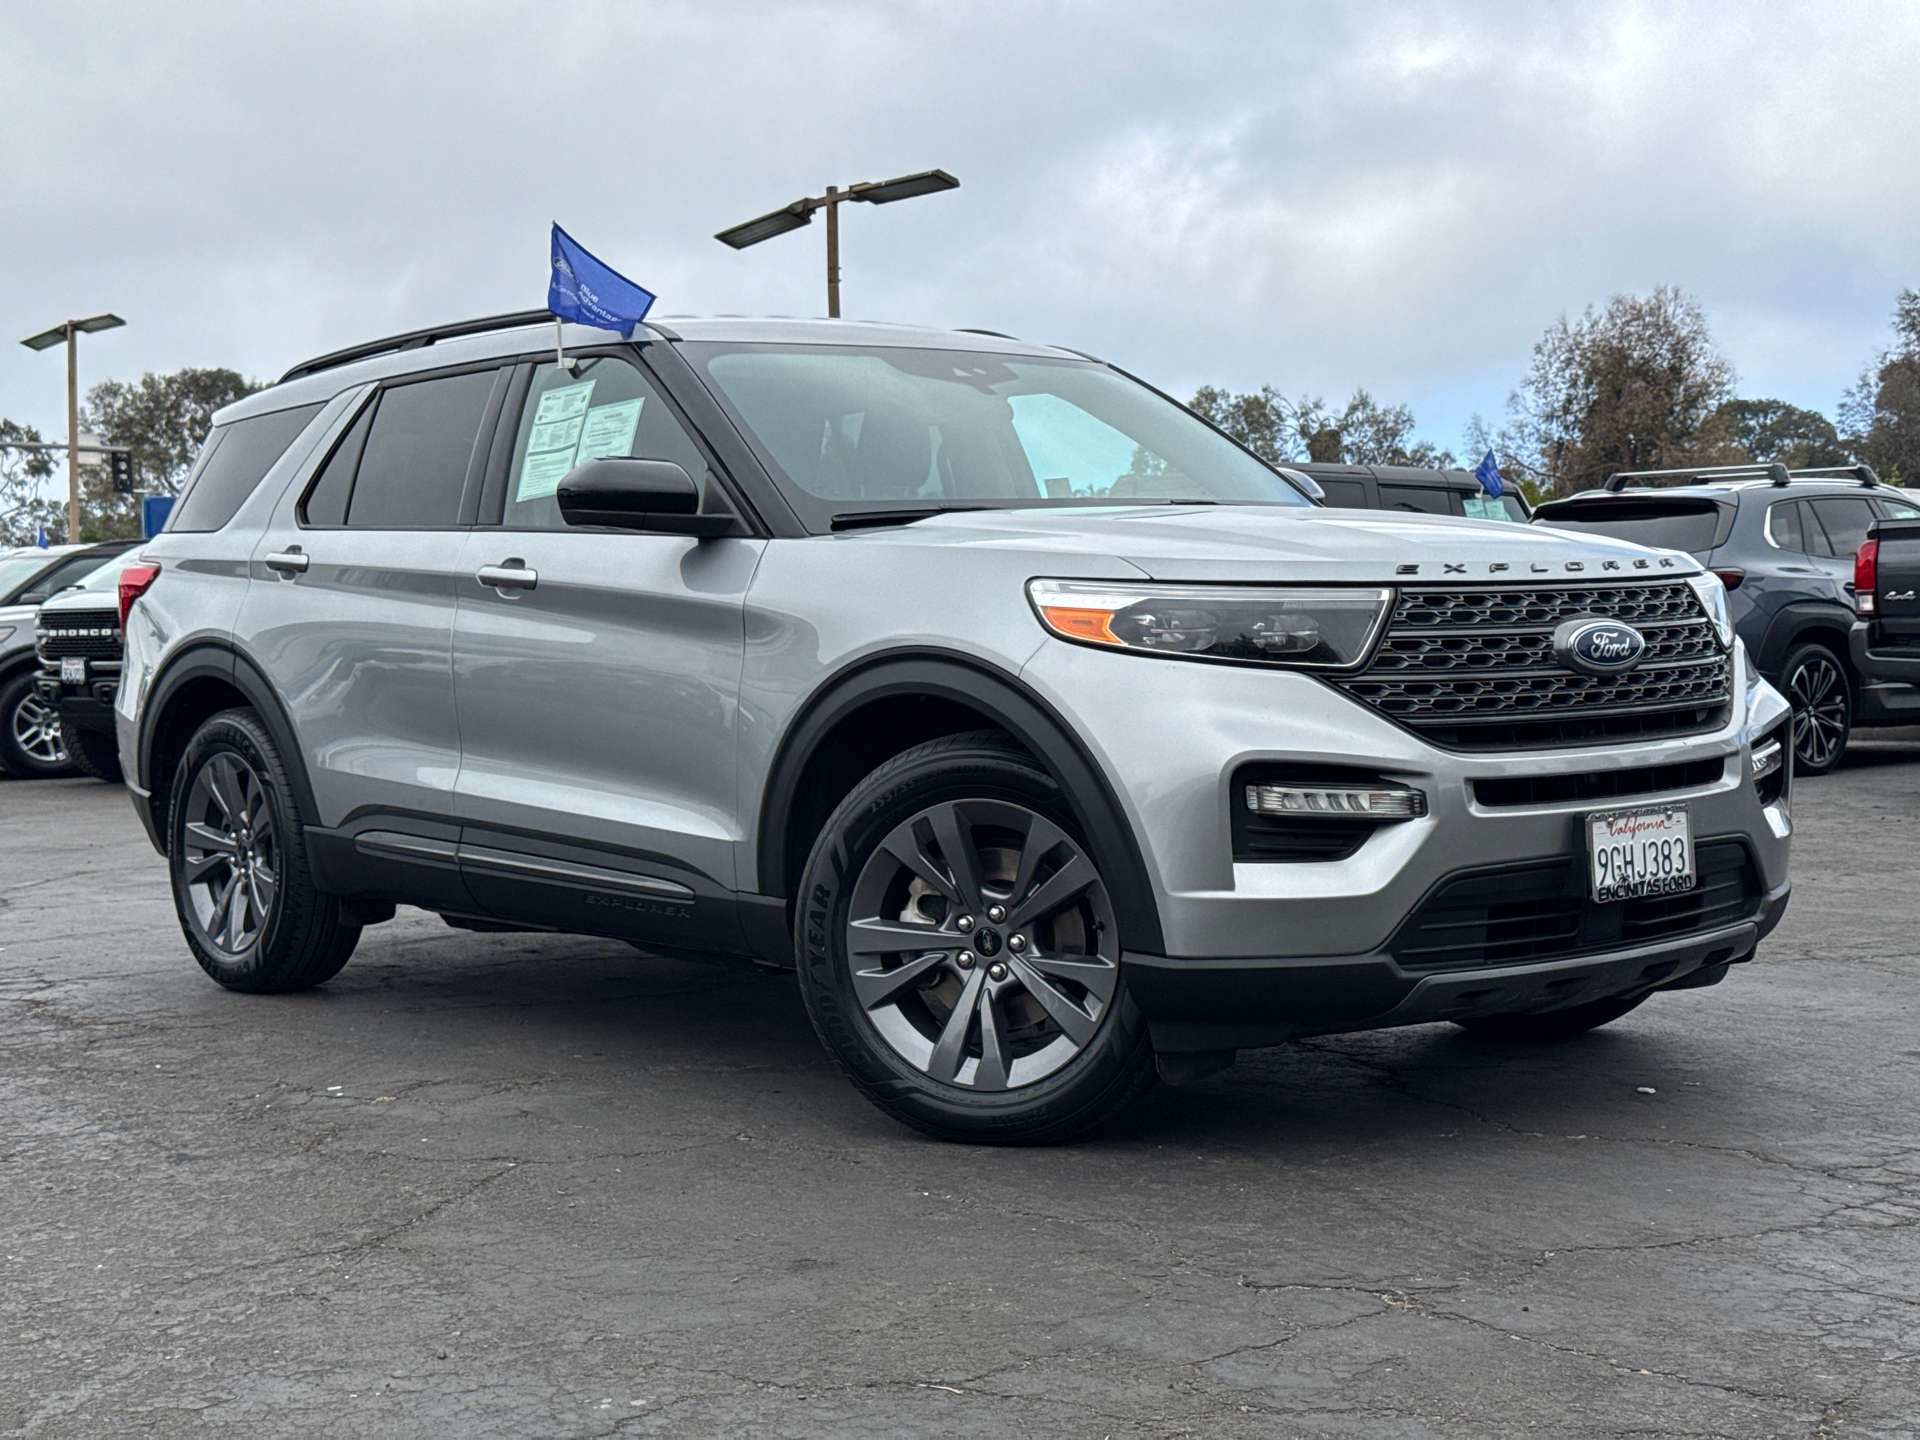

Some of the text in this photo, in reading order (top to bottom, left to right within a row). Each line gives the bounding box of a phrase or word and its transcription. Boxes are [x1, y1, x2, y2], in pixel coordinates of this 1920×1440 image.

[580, 284, 599, 303] Blue
[1396, 557, 1676, 575] EXPLORER
[49, 628, 112, 637] BRONCO
[1591, 631, 1632, 659] Ford
[1609, 816, 1672, 839] California
[1597, 837, 1686, 886] 9GHJ383
[1598, 874, 1692, 902] ENCINITAS FORD
[585, 894, 691, 918] EXPLORER
